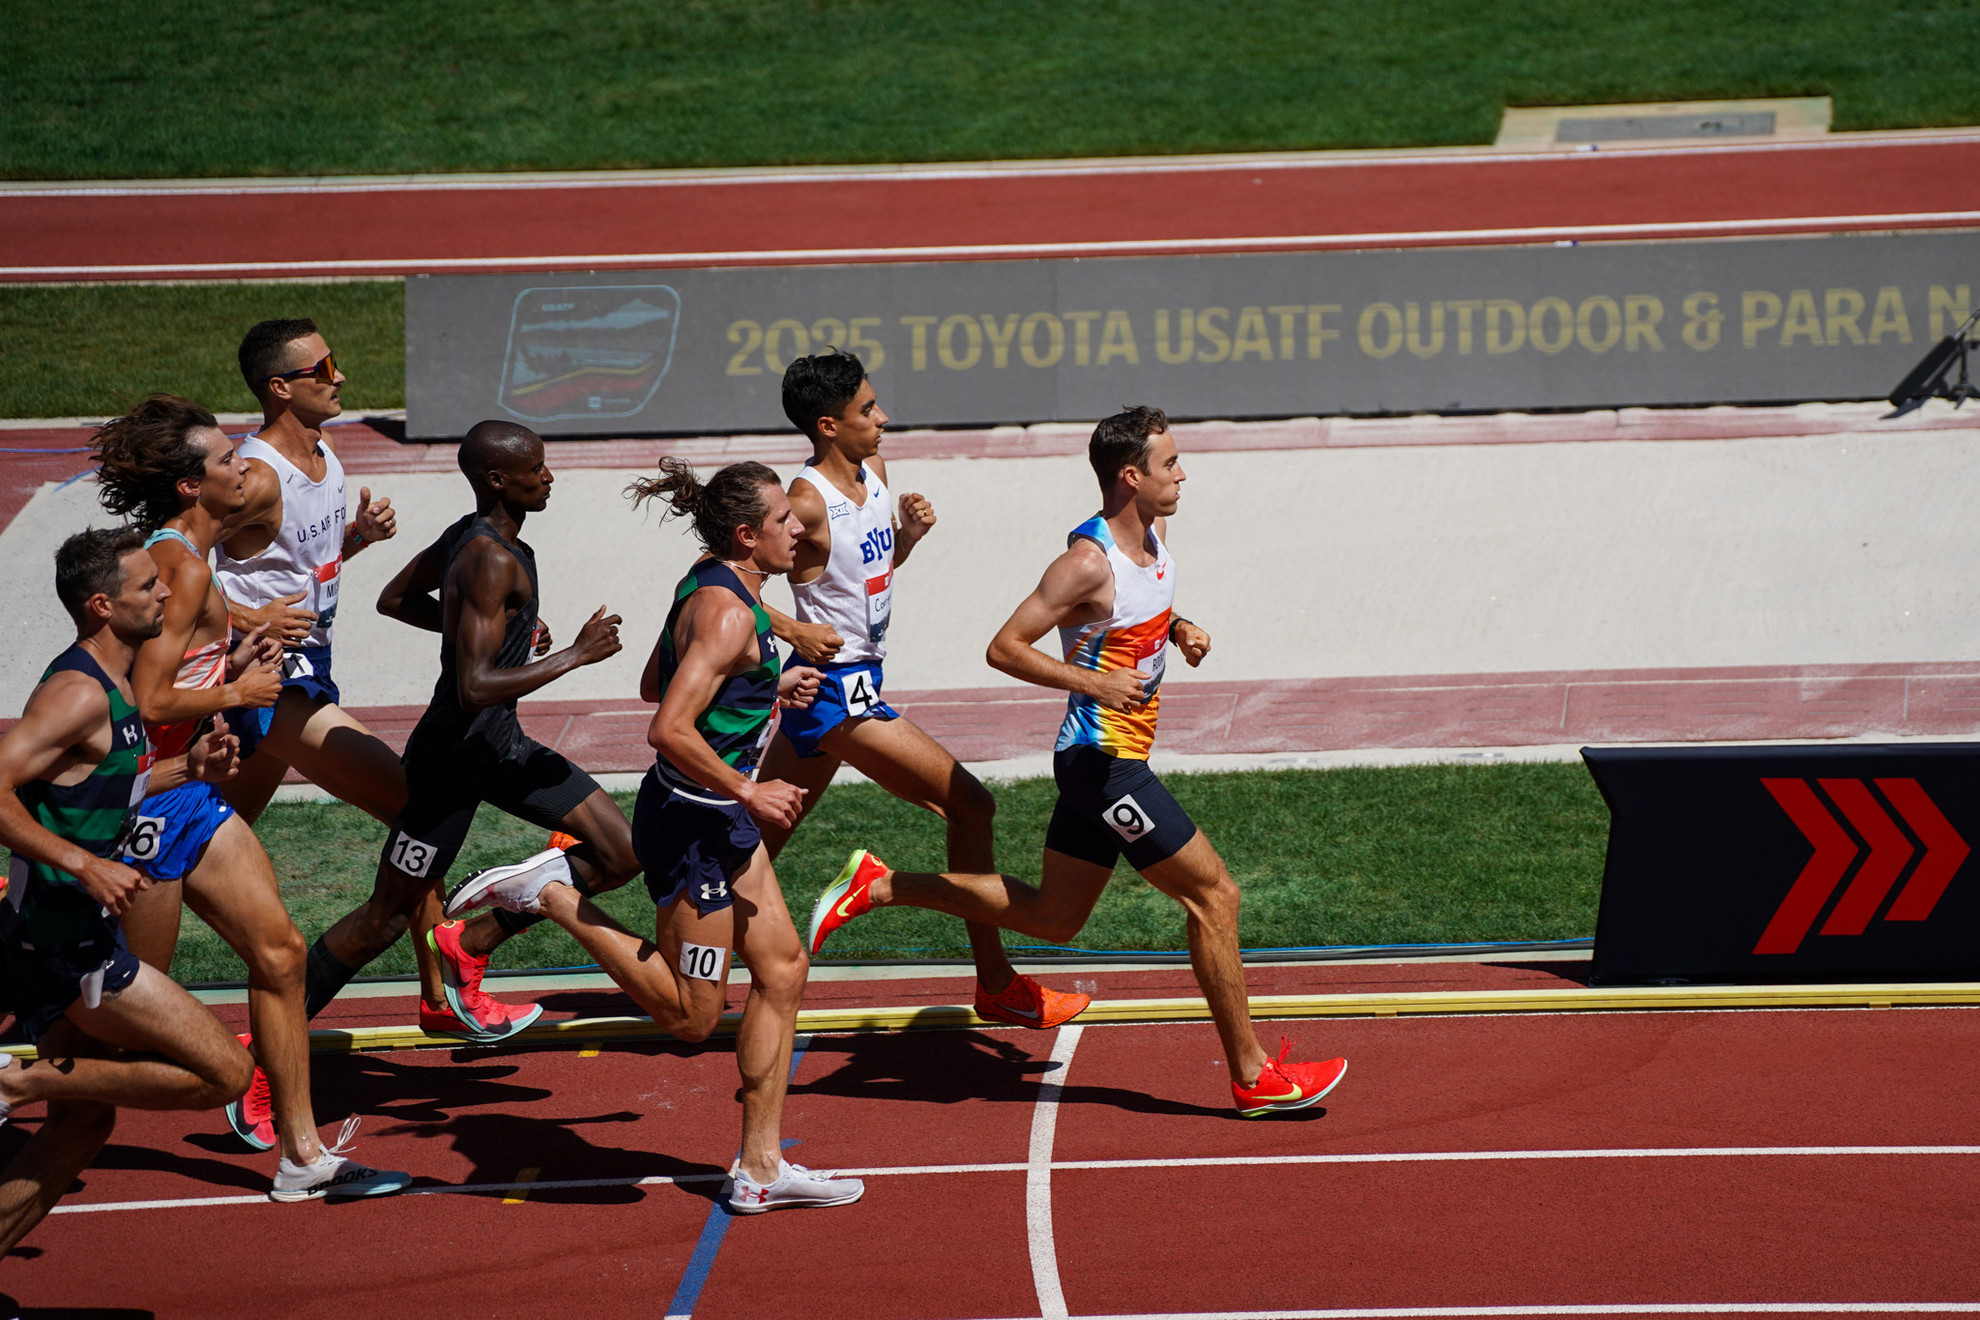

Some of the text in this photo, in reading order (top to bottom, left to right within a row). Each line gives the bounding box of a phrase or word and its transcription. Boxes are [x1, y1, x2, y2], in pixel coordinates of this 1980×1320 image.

[726, 317, 886, 376] 2025
[901, 310, 1140, 371] TOYOTA
[1155, 304, 1342, 364] USATF
[1357, 295, 1665, 360] OUTDOOR
[1682, 291, 1725, 351] &
[1741, 286, 1914, 348] PARA
[860, 527, 892, 565] BYU
[850, 675, 872, 706] 4
[1113, 803, 1144, 835] 9
[130, 821, 158, 856] 6
[398, 839, 428, 872] 13
[687, 946, 717, 977] 10
[307, 1168, 378, 1196] BROOKS
